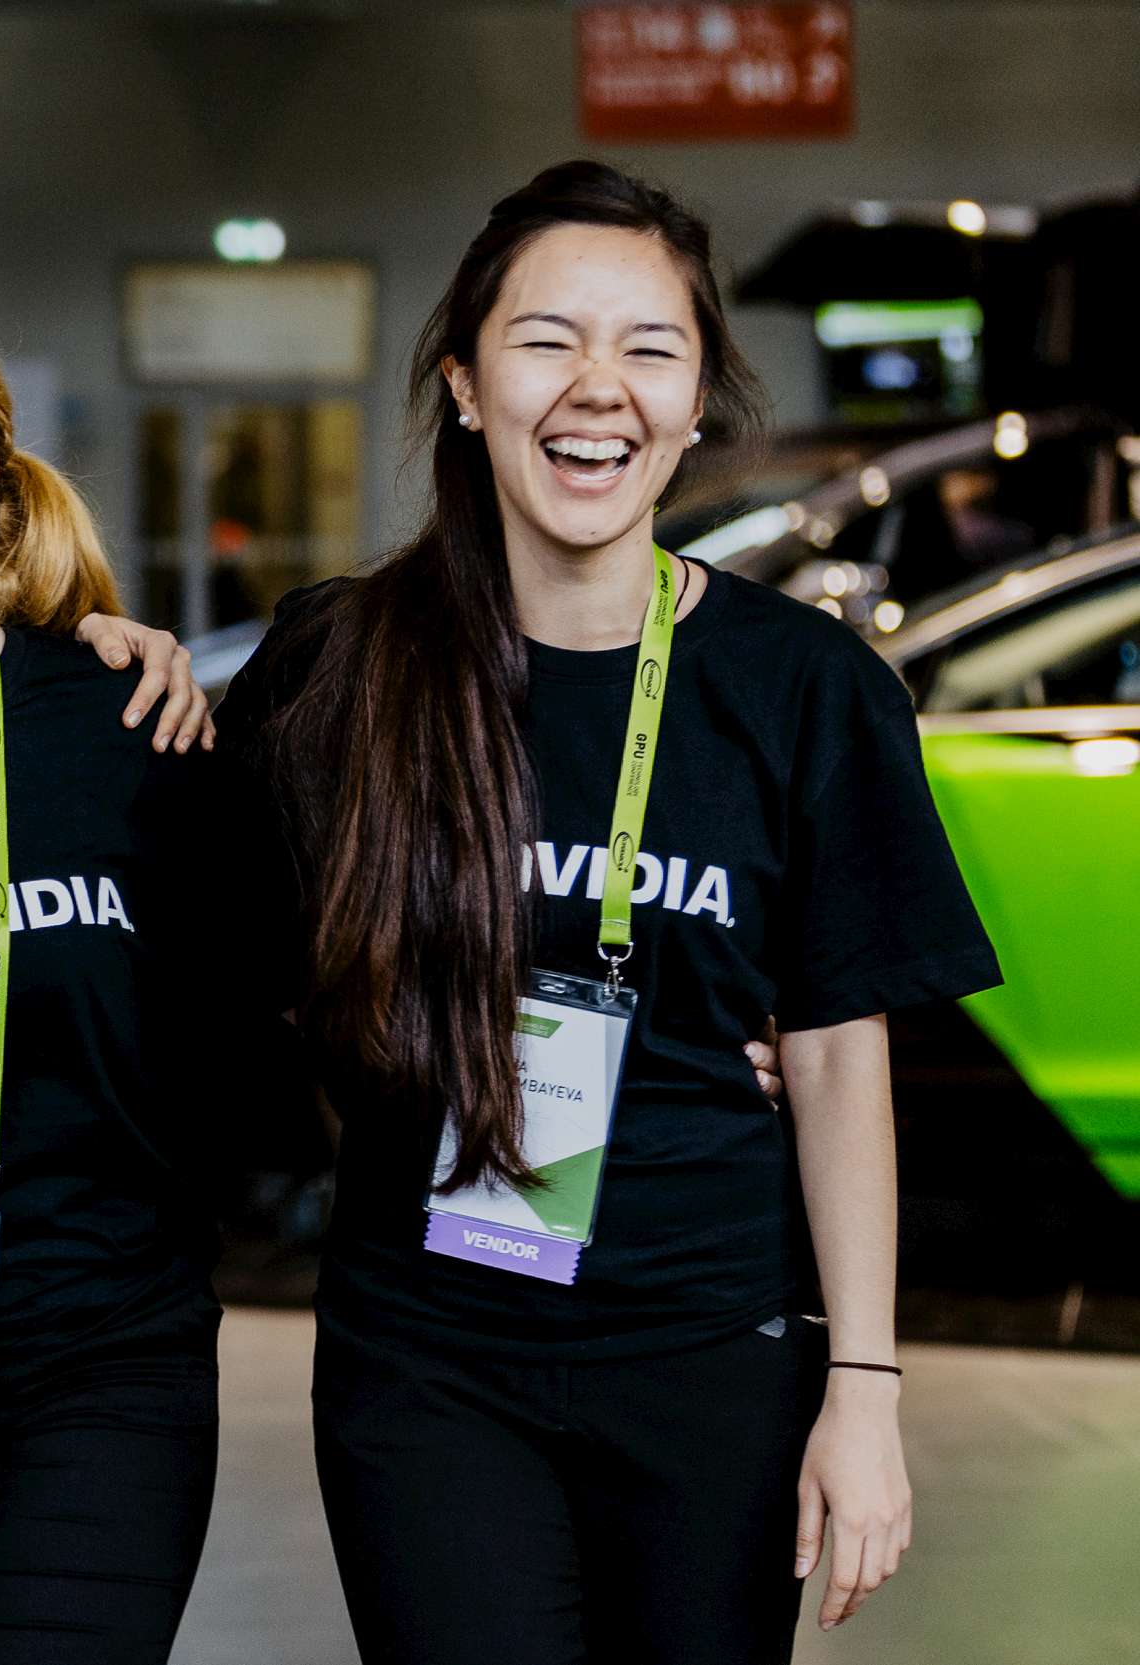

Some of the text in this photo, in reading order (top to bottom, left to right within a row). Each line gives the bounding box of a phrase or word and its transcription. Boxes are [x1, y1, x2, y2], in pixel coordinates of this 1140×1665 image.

[633, 733, 647, 759] GPU
[520, 1078, 584, 1103] MBAYEVA
[462, 1229, 540, 1261] VENDOR
